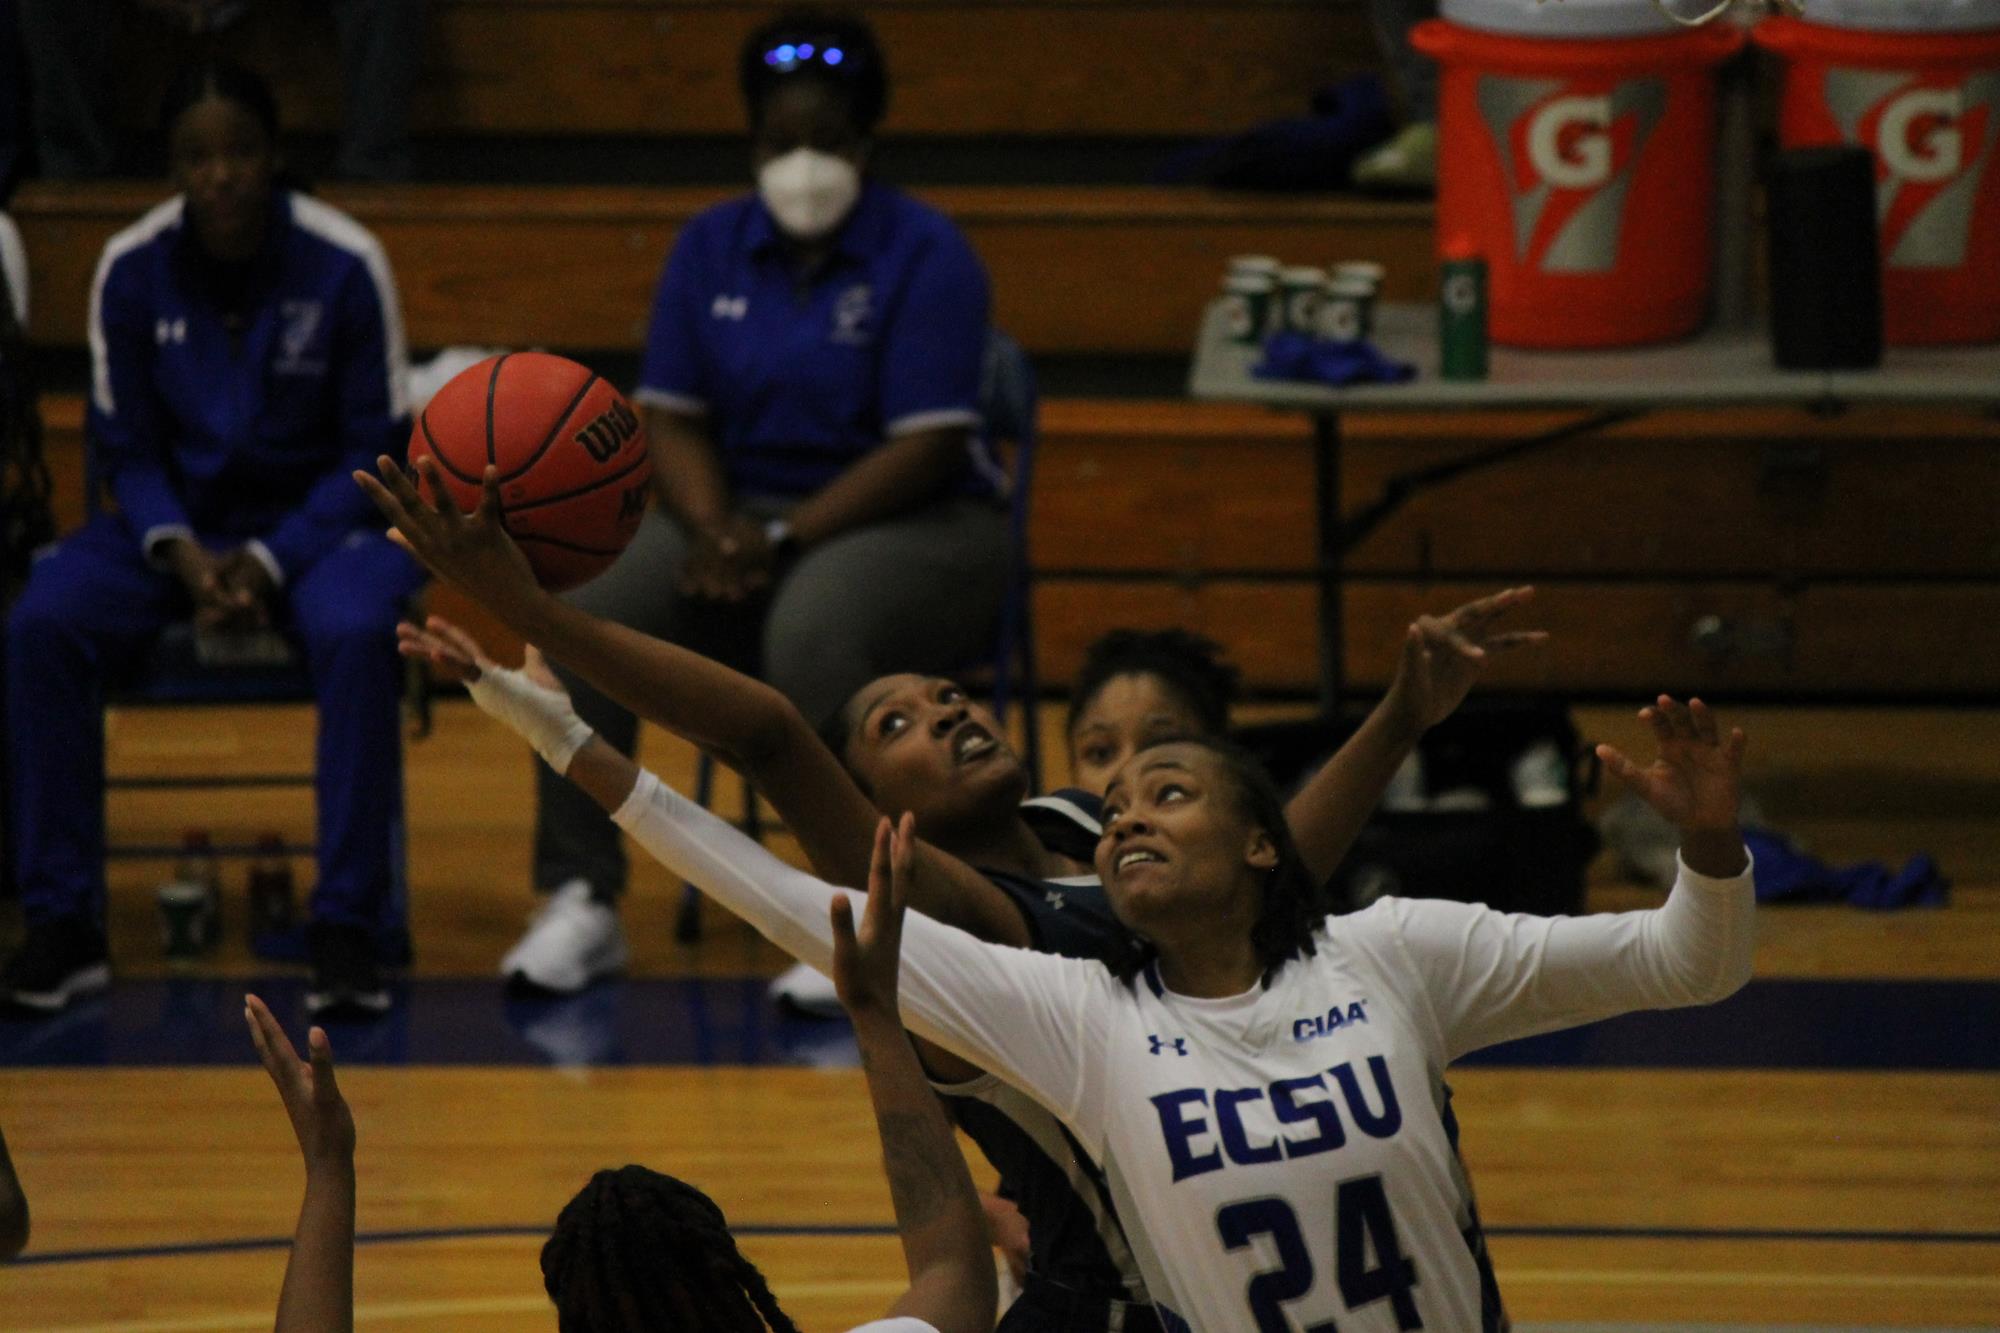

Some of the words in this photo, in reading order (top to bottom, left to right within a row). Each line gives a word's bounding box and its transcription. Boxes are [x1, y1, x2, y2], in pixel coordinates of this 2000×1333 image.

[1528, 96, 1613, 188] G
[1877, 89, 1964, 182] G
[1293, 1001, 1368, 1042] CIAA
[1149, 1054, 1402, 1183] ECSU
[1215, 1172, 1424, 1333] 24
